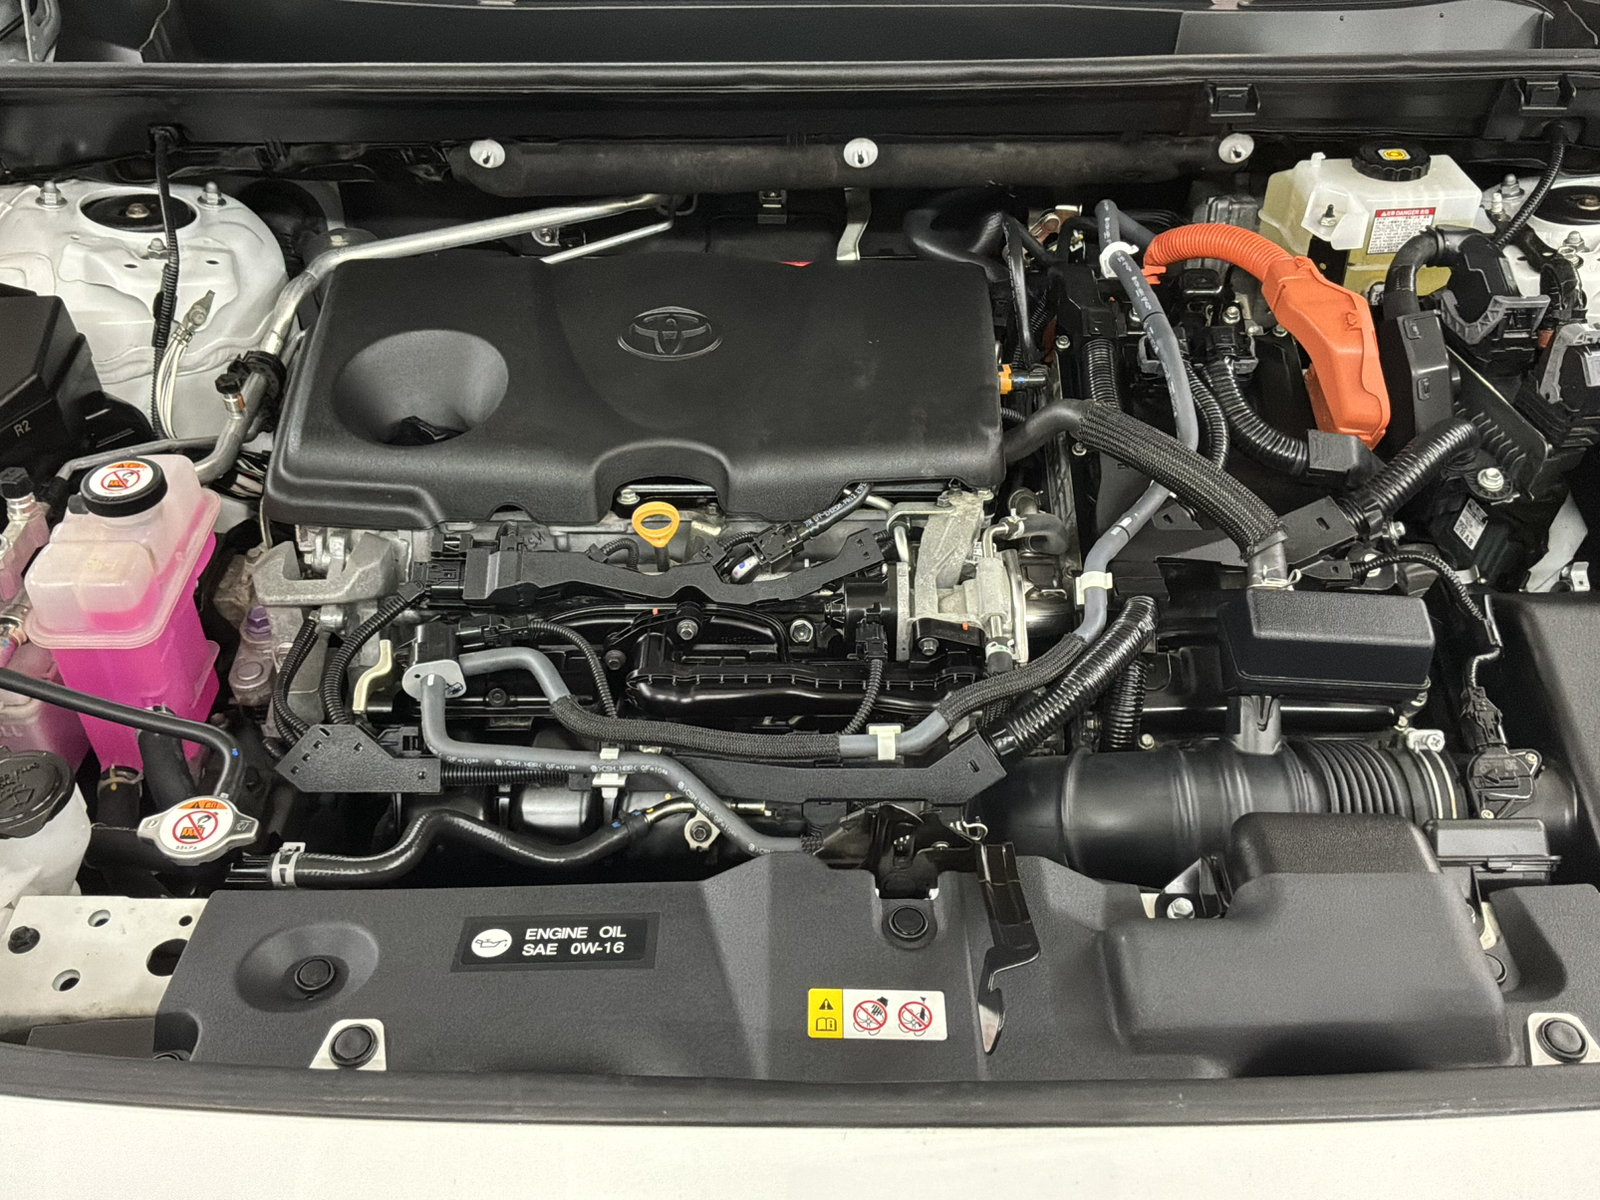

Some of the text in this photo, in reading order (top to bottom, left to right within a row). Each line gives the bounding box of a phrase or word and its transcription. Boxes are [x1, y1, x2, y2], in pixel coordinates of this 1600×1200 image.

[13, 420, 31, 437] R2
[525, 925, 627, 940] ENGINE OIL
[522, 941, 625, 956] SAE 0W-16
